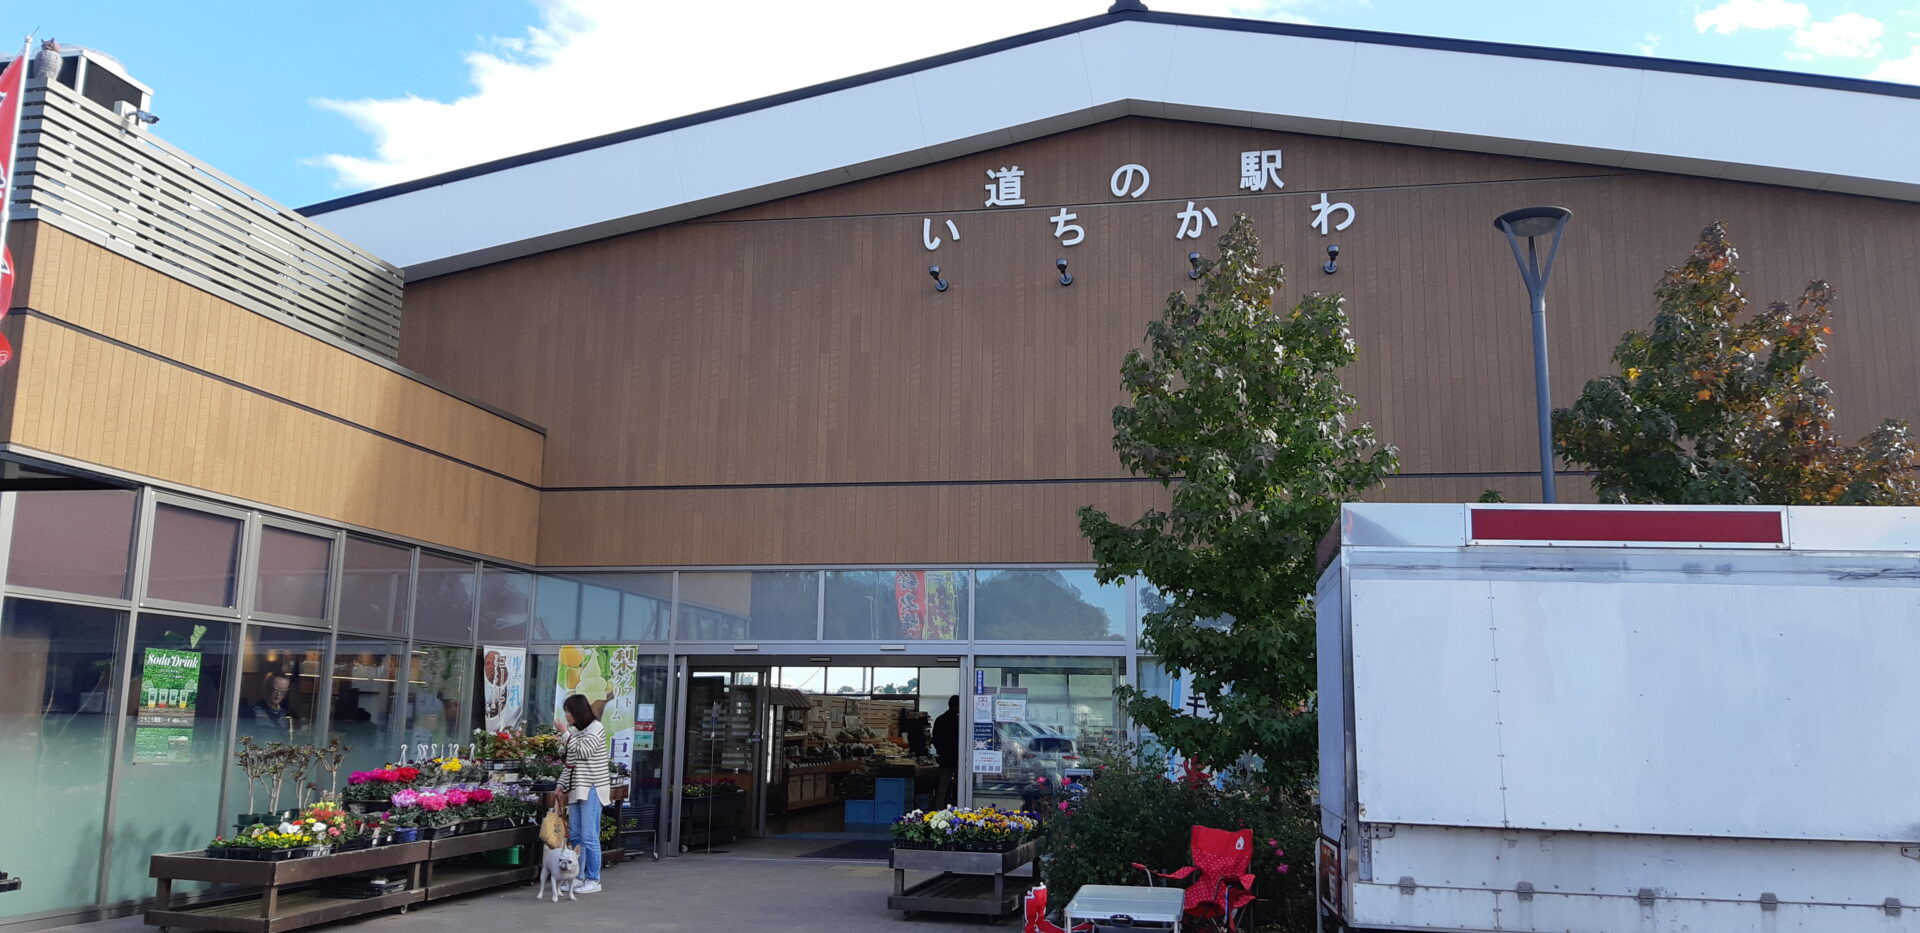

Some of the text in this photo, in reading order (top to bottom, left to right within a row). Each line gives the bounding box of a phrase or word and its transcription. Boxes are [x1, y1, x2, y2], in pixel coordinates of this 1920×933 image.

[984, 149, 1285, 207] 道の駅
[922, 193, 1356, 250] いちかわ
[146, 653, 198, 668] Soda Drink
[613, 648, 636, 672] 梨
